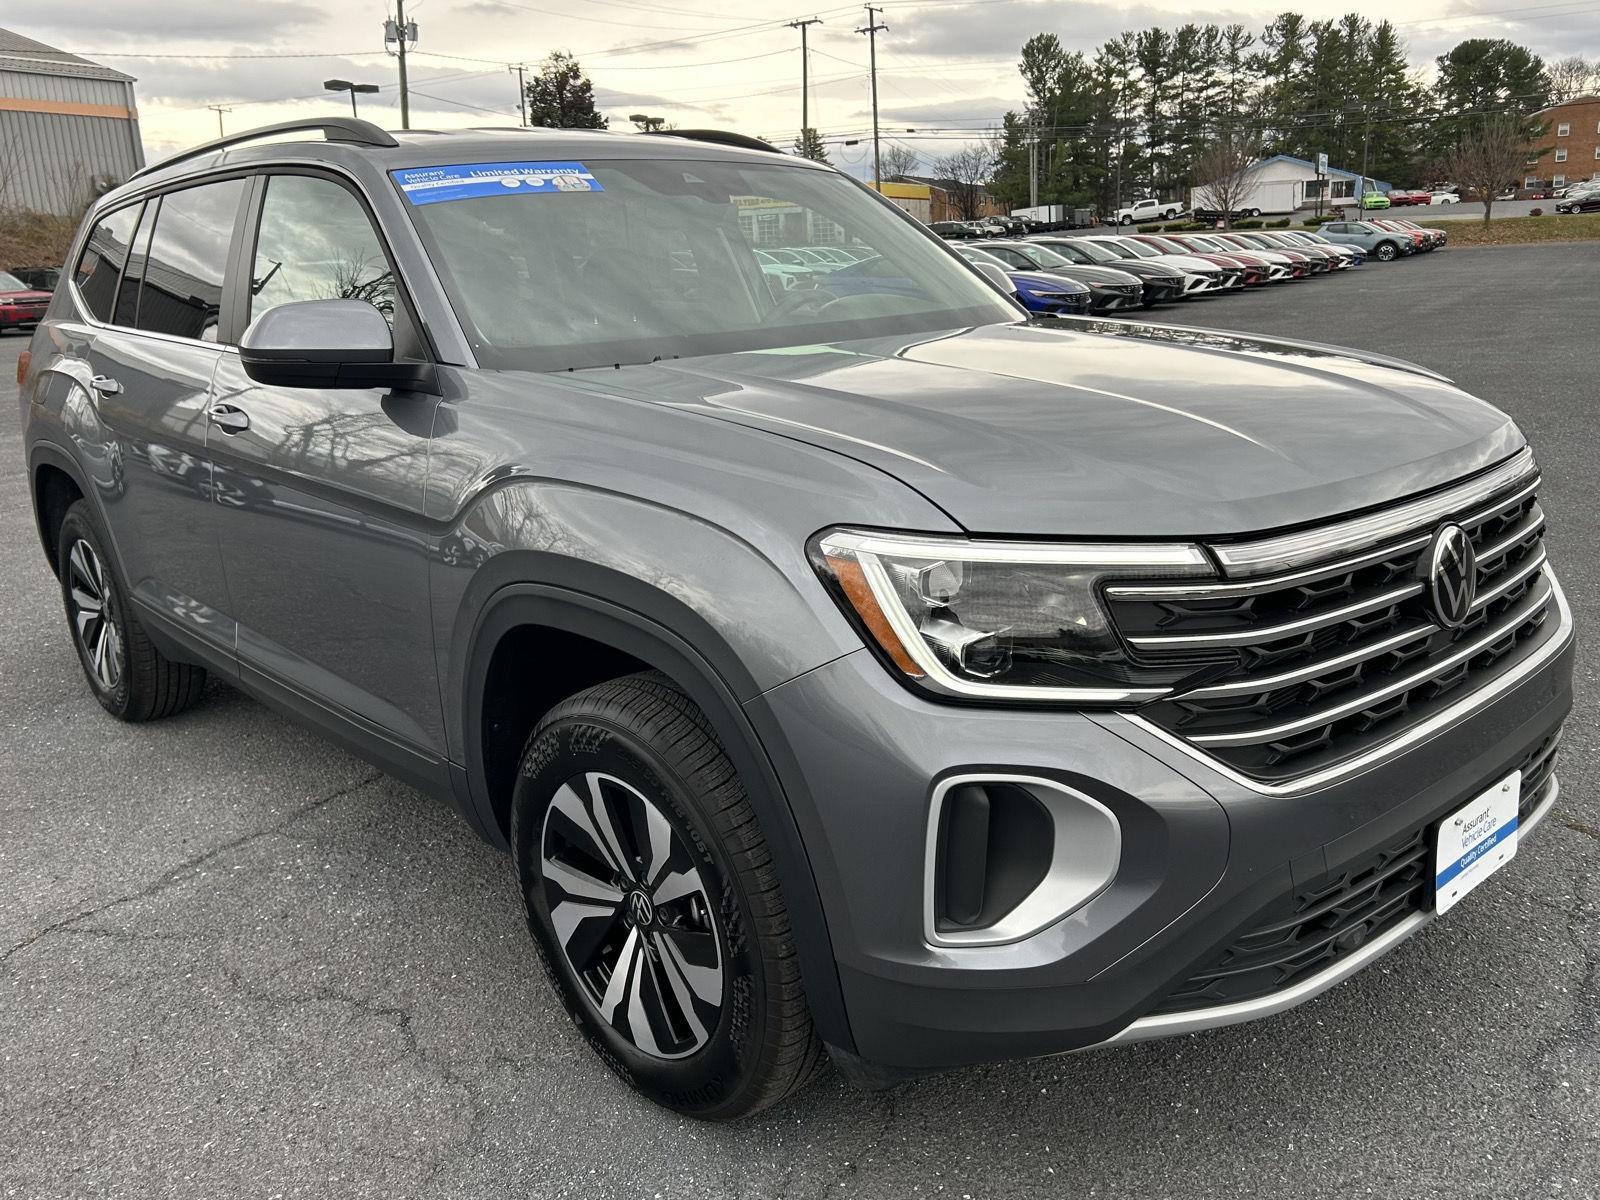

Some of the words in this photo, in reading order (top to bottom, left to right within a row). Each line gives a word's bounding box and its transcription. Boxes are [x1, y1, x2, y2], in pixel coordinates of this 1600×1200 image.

[404, 170, 445, 180] Assurant
[406, 175, 439, 184] Vehicle
[470, 168, 520, 178] Limited
[520, 167, 579, 176] Warranty
[1462, 808, 1489, 834] Assurant
[1461, 827, 1483, 849] Vehicle
[1483, 817, 1497, 834] Care
[1460, 851, 1476, 868] Quality
[1477, 834, 1497, 855] Certified
